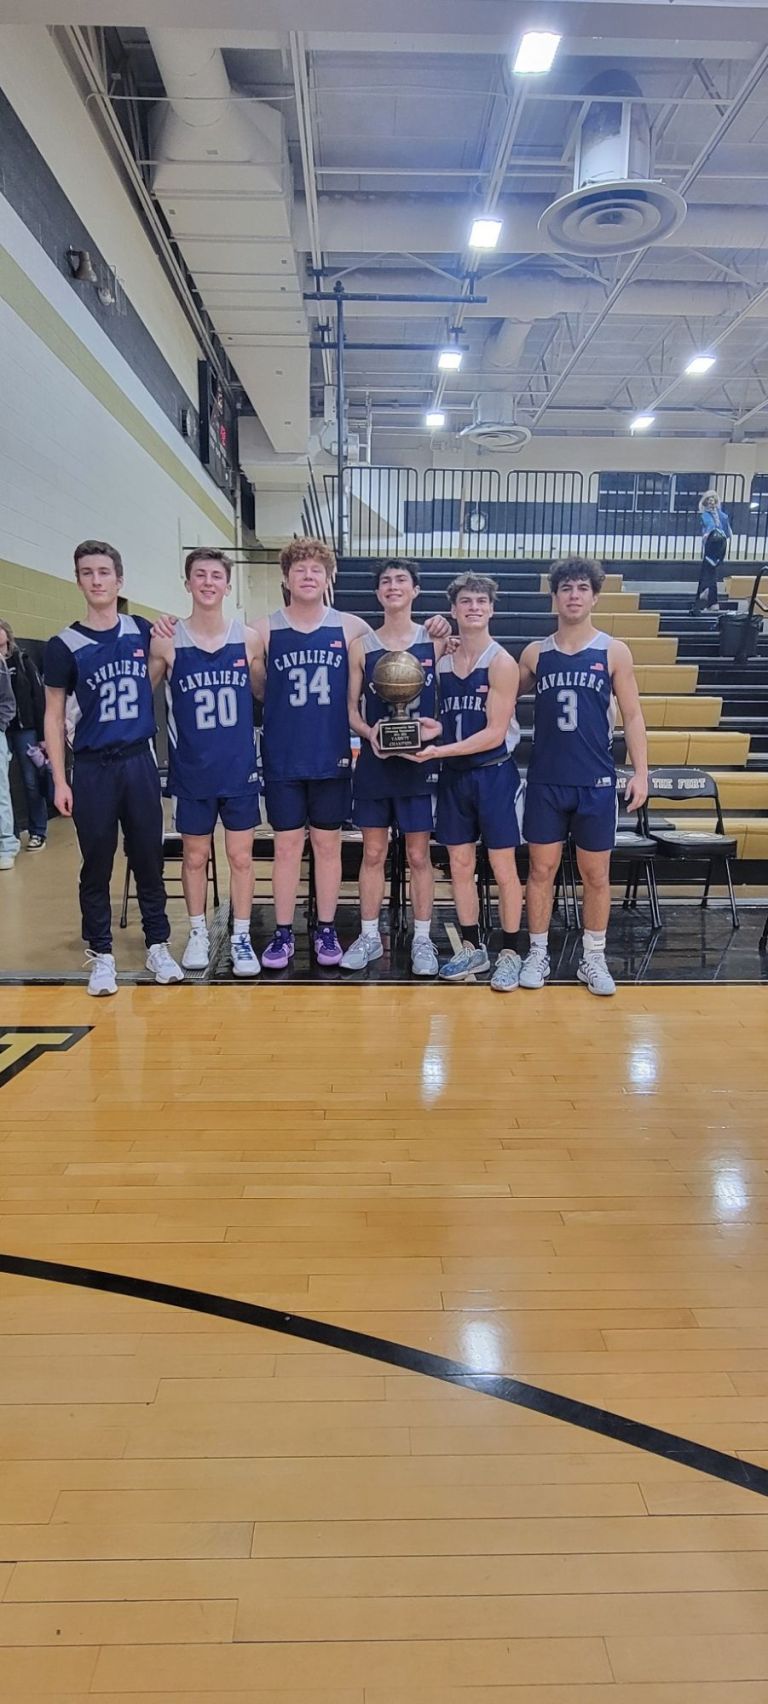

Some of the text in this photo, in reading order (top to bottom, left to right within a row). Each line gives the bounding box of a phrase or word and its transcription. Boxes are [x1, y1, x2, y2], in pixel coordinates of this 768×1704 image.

[274, 649, 343, 671] CAVALIERS
[178, 670, 248, 693] CAVALIERS
[288, 665, 331, 707] 34
[536, 671, 604, 694] CAVALIERS
[98, 677, 138, 722] 22
[193, 686, 238, 730] 20
[556, 689, 578, 732] 3
[455, 713, 463, 742] 1
[651, 777, 706, 789] THE FORT
